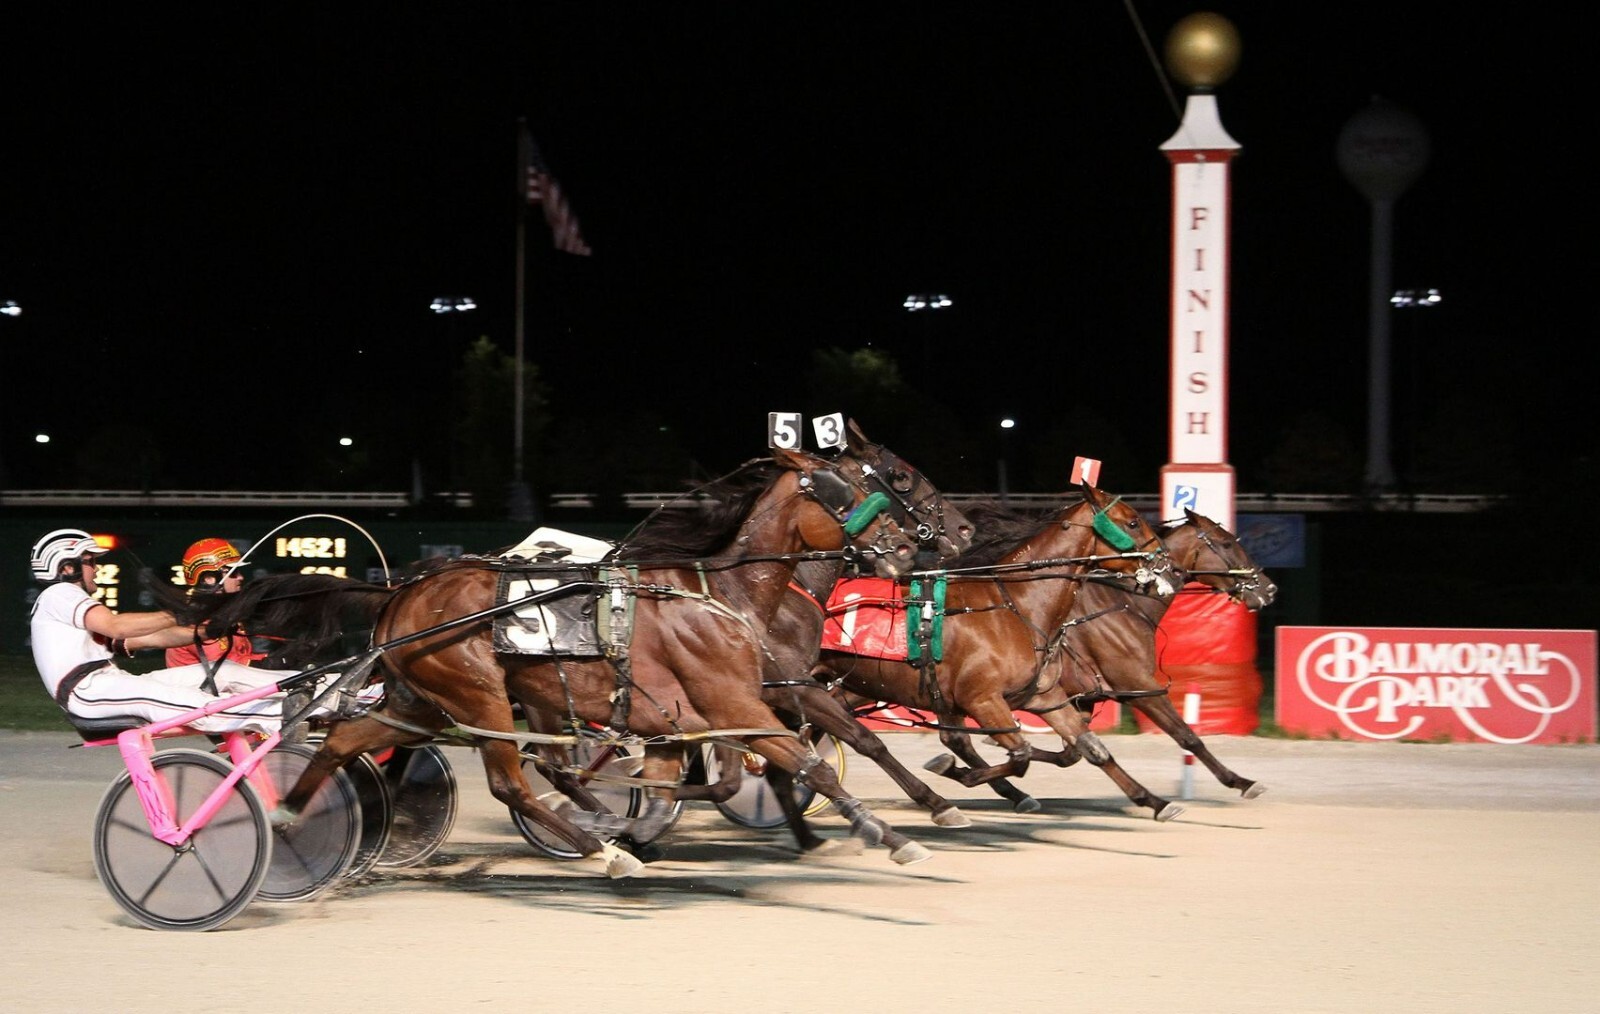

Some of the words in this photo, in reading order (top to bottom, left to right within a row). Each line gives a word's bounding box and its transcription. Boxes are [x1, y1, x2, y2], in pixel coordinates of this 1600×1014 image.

[1186, 206, 1211, 435] FINISH
[773, 413, 797, 448] 5
[820, 417, 840, 445] 3
[1079, 458, 1093, 485] 1
[1175, 486, 1196, 510] 2
[506, 578, 560, 650] 5
[840, 592, 862, 647] 1
[1299, 631, 1578, 702] BALMORAL
[1338, 676, 1512, 738] PARK
